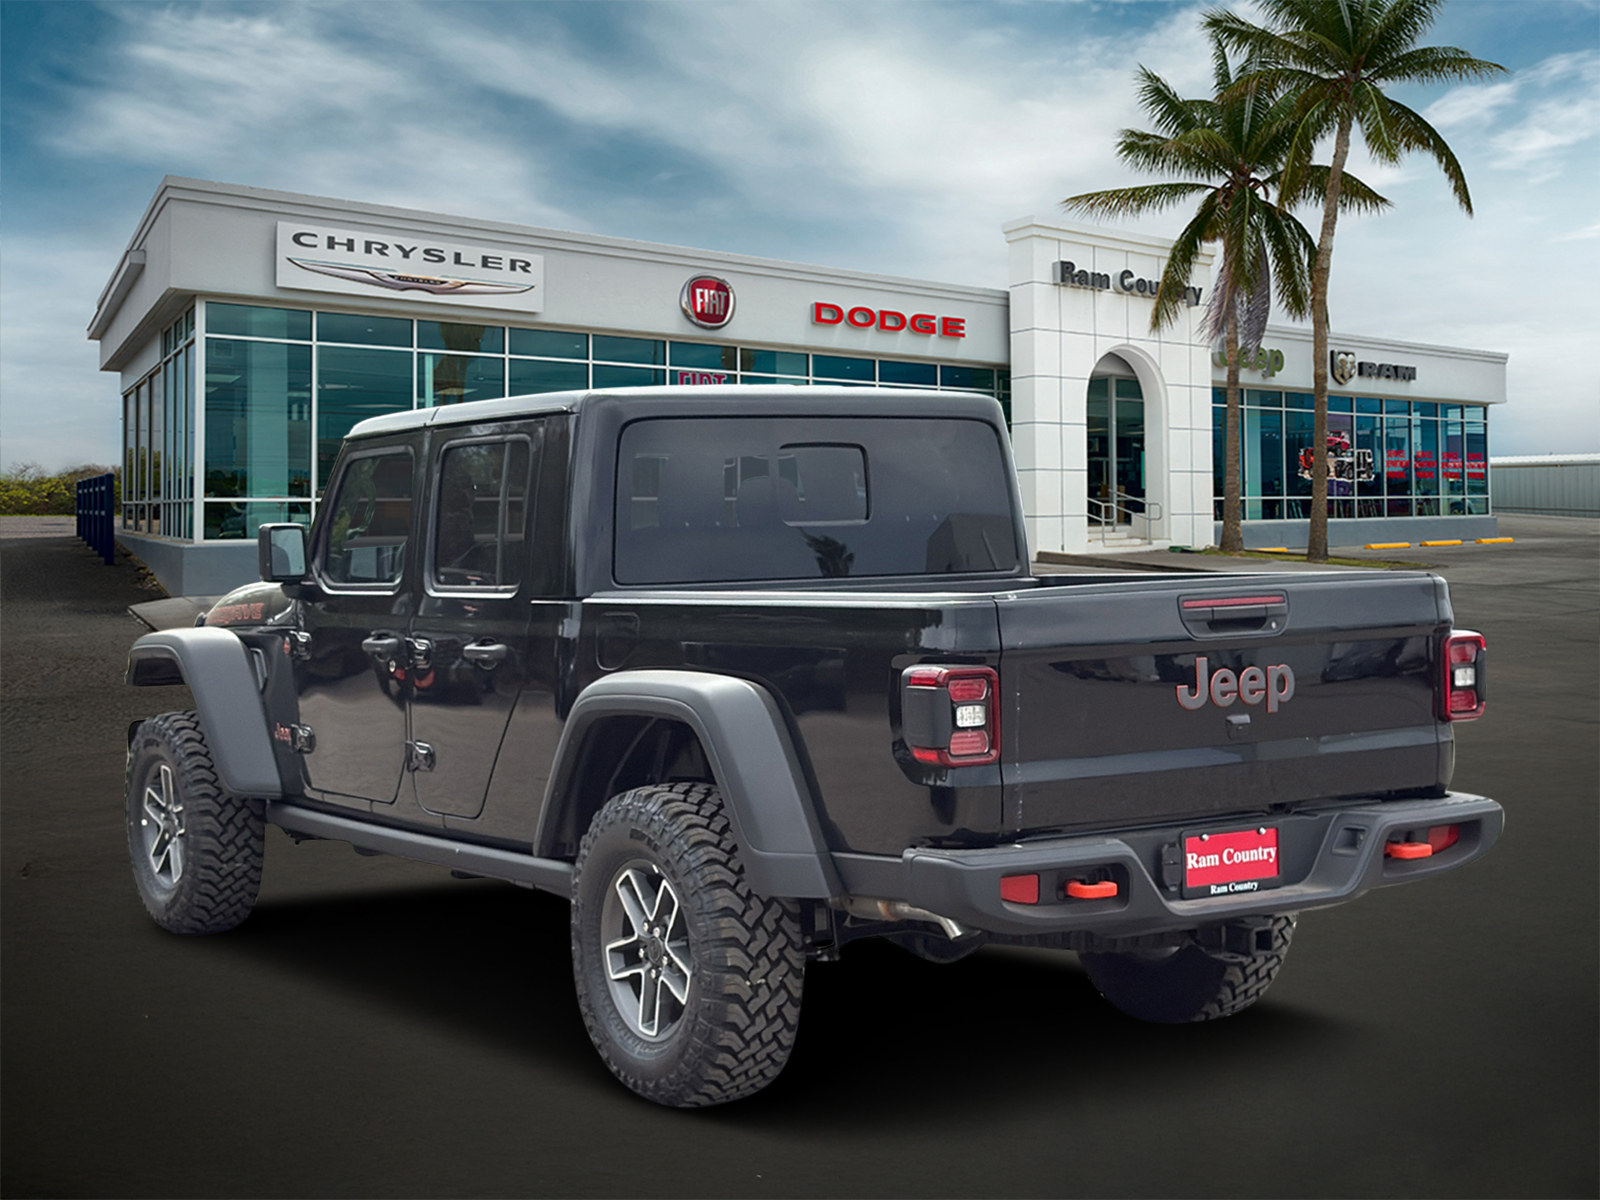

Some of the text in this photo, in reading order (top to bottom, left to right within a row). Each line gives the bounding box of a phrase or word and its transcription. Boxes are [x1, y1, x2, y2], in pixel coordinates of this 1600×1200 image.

[291, 231, 533, 274] CHRYSLER
[1053, 260, 1203, 308] Ram Coury
[695, 287, 728, 316] FIAT
[811, 301, 966, 339] DODGE
[1358, 361, 1417, 382] RAM
[1176, 656, 1296, 714] Jeep
[1186, 846, 1278, 870] Ram Country
[1210, 881, 1259, 895] Ram Country
